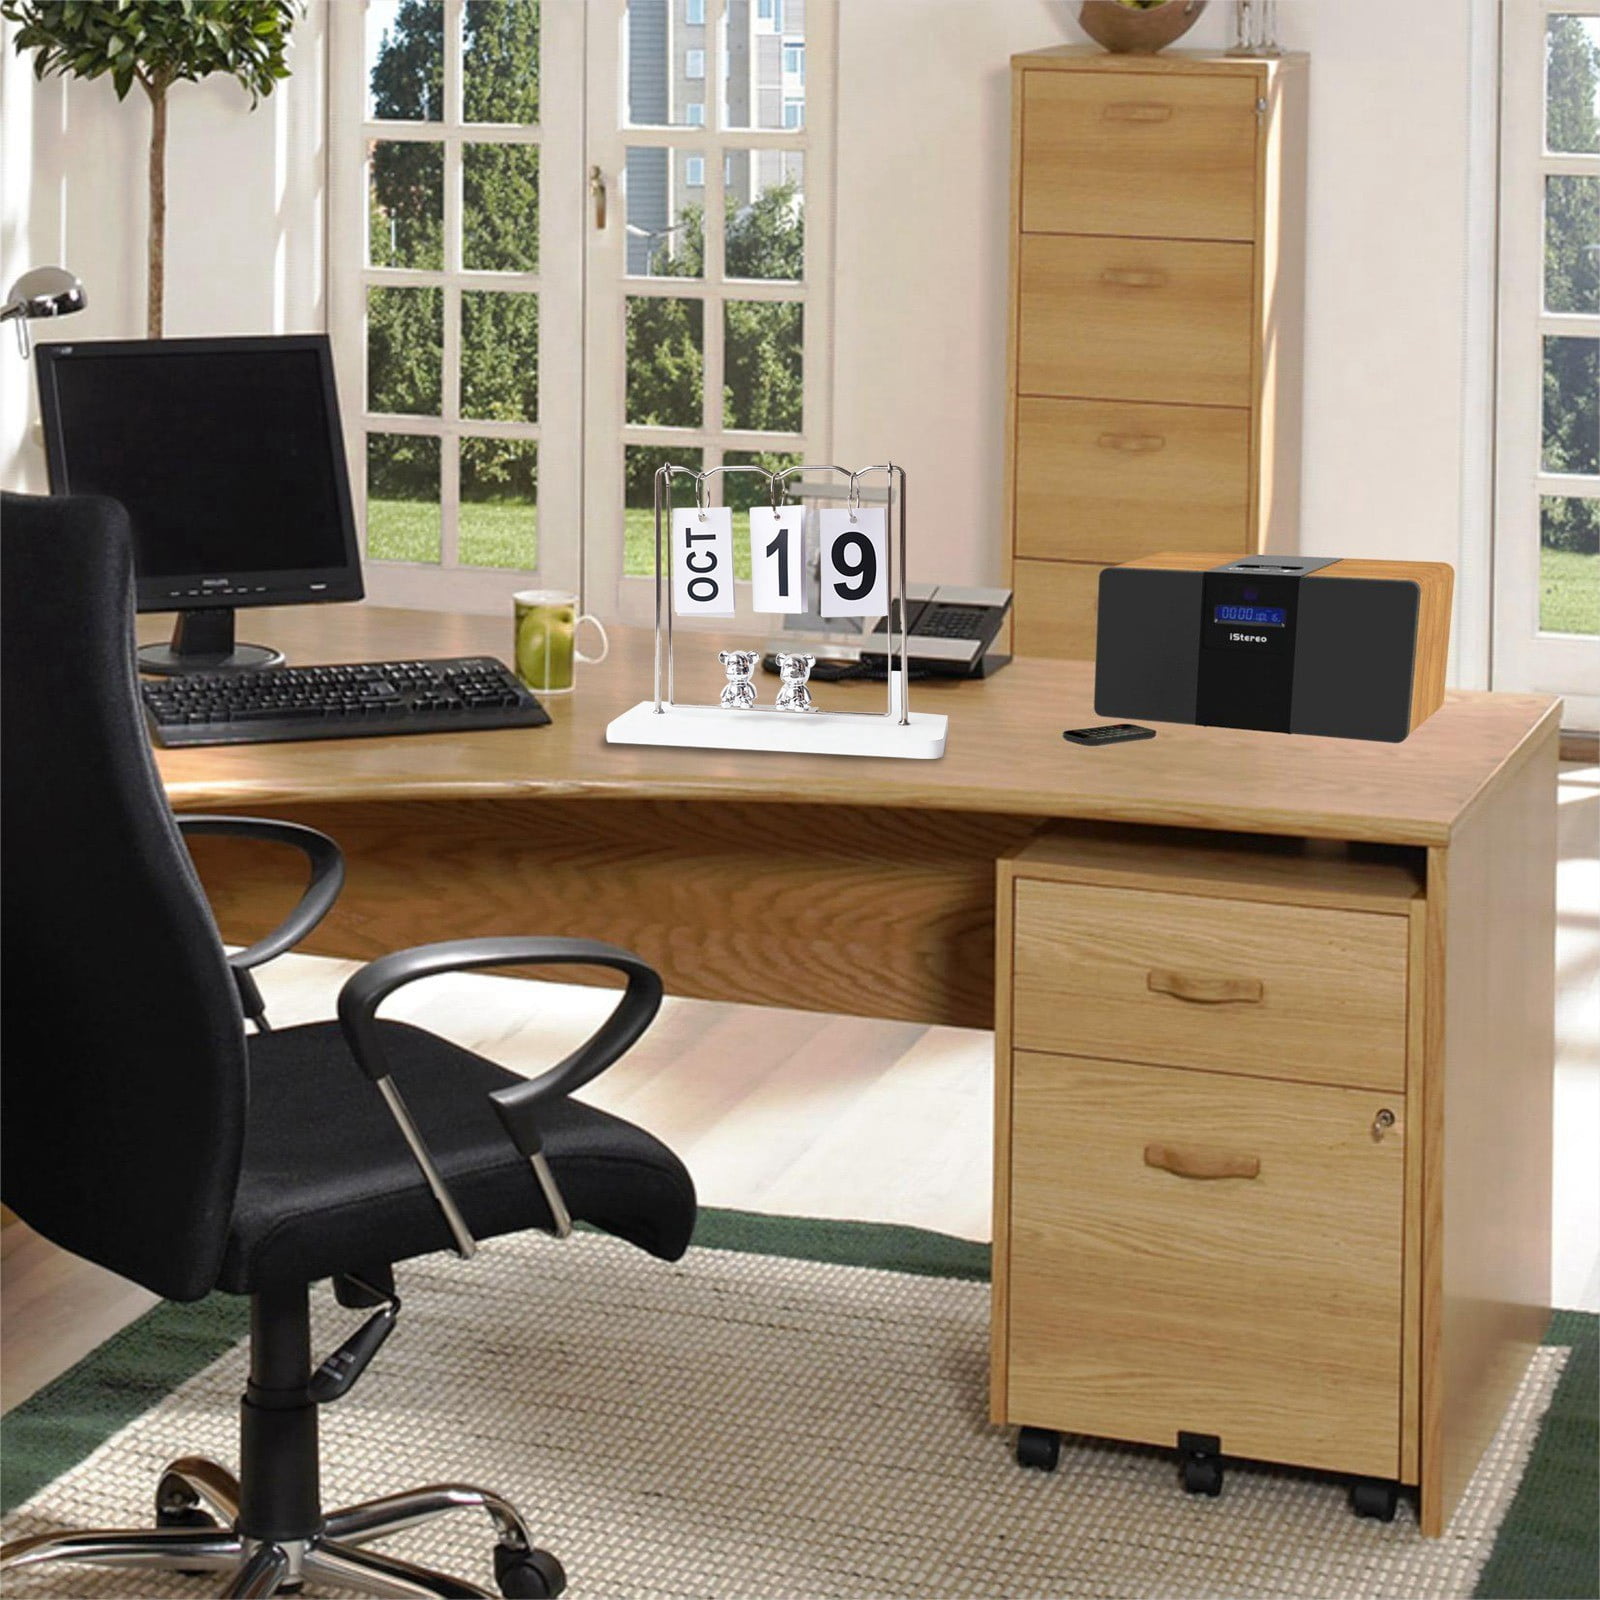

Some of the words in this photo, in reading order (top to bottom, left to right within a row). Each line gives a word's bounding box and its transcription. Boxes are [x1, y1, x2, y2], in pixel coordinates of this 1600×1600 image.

[685, 527, 719, 602] OCT
[766, 528, 789, 597] 1
[831, 531, 877, 601] 9
[1229, 632, 1268, 643] iStereo
